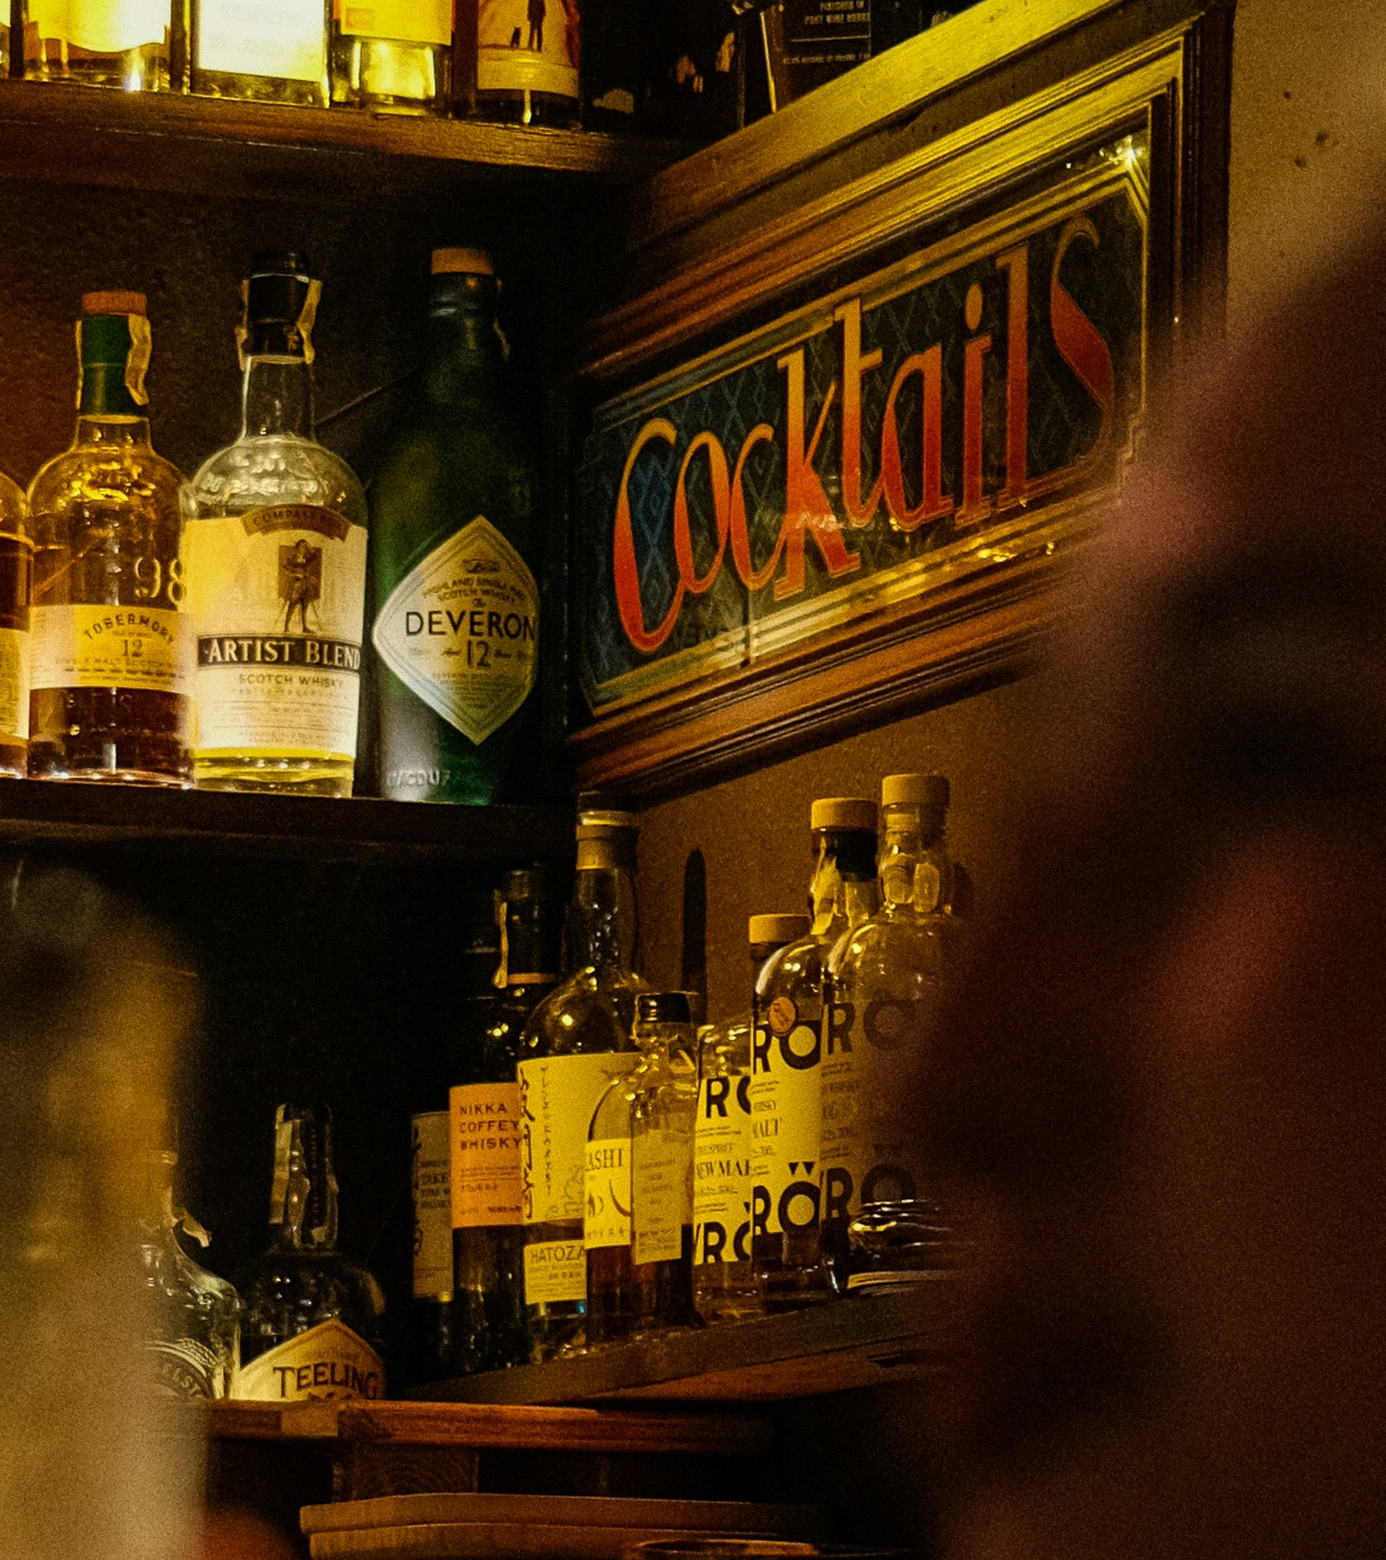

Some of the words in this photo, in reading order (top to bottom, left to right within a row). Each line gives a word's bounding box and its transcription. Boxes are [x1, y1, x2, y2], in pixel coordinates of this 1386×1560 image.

[405, 610, 537, 642] DEVERON
[121, 638, 144, 658] 12
[207, 638, 295, 664] ARTIST
[305, 641, 361, 671] BLEND
[466, 639, 492, 668] 12
[239, 673, 294, 685] SCOTCH
[299, 675, 344, 689] WHISKY
[460, 1102, 508, 1116] NIKKA
[460, 1119, 521, 1134] COFFEY
[461, 1137, 522, 1151] WHISKY
[753, 1161, 821, 1235] RÖ
[530, 1244, 587, 1263] HATOZA
[272, 1361, 379, 1401] TEELING
